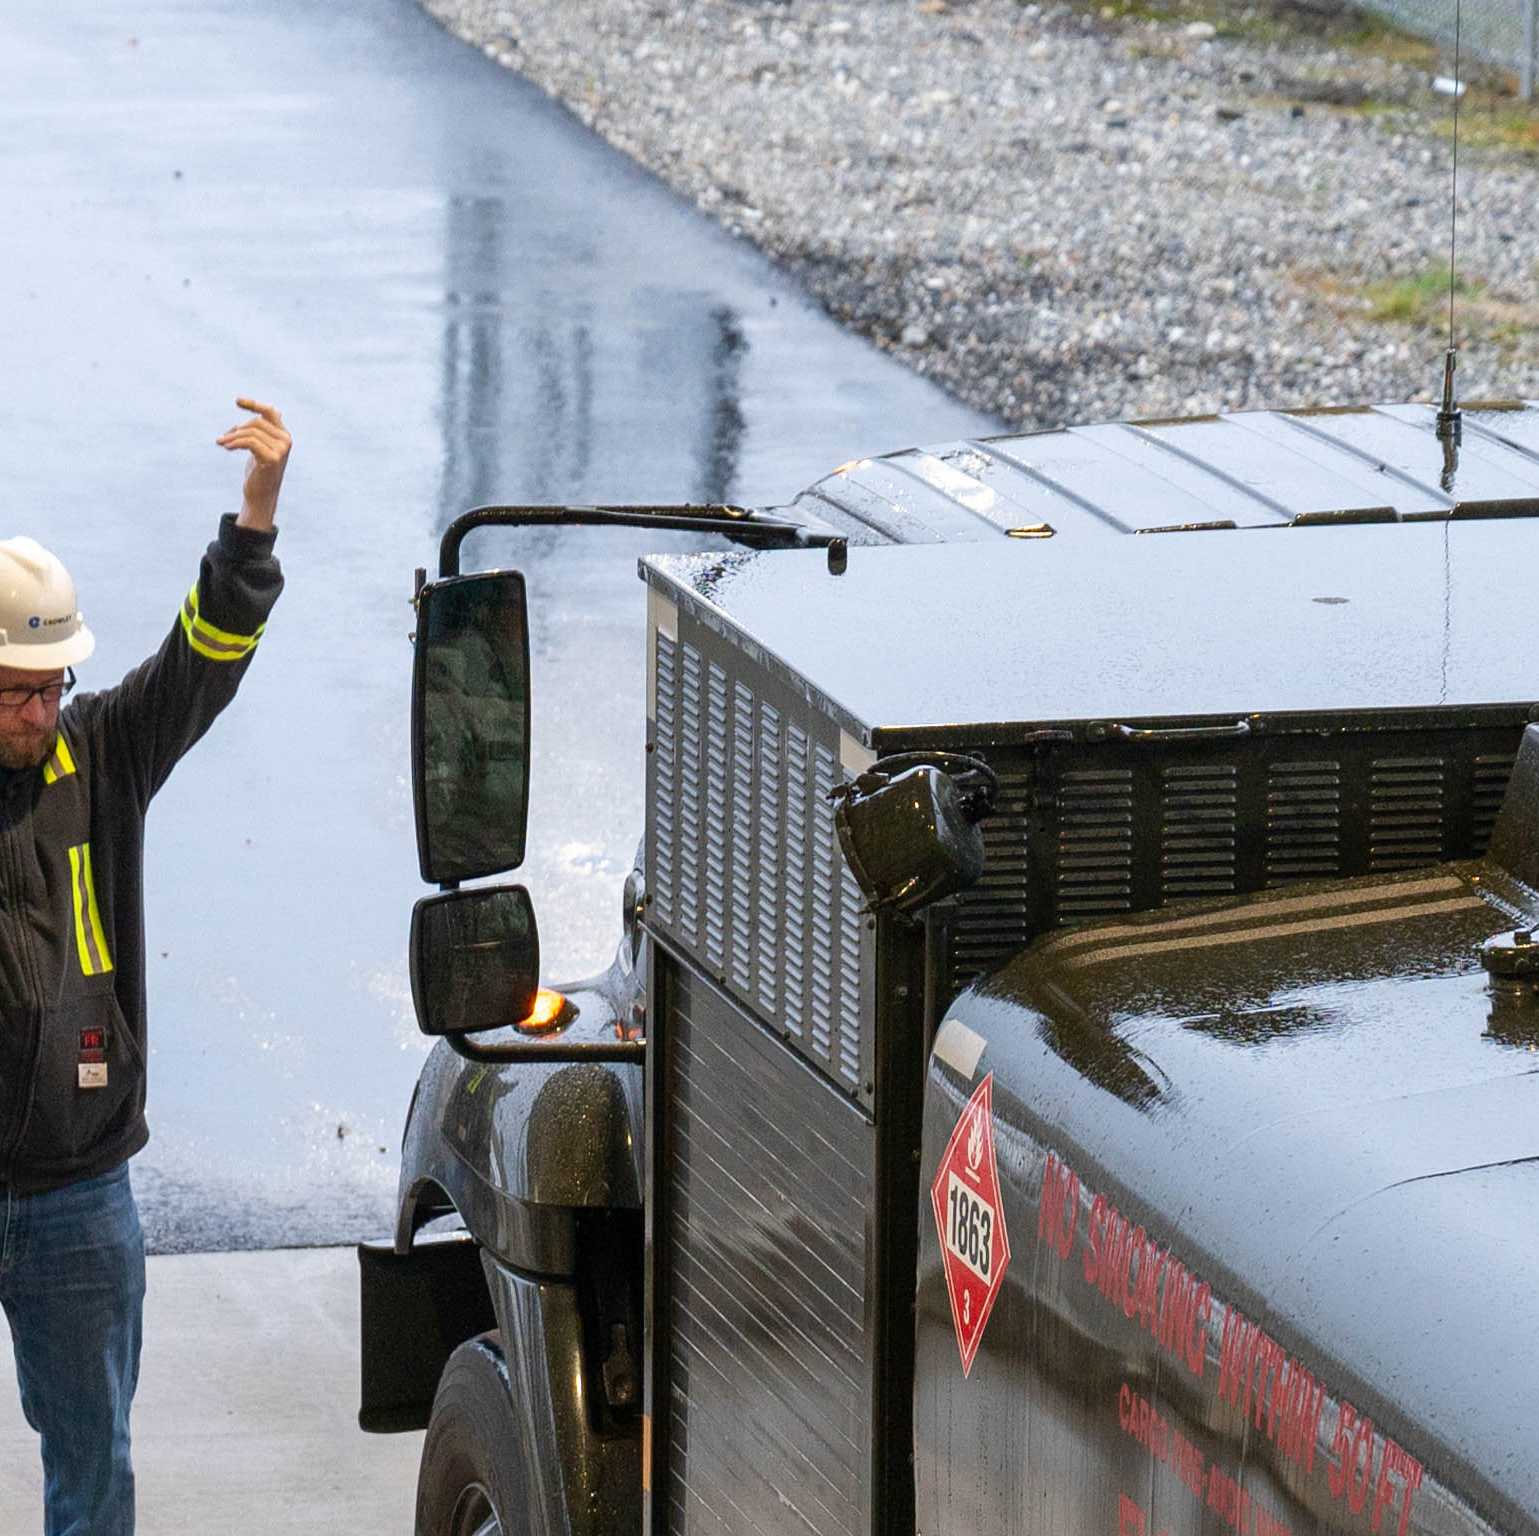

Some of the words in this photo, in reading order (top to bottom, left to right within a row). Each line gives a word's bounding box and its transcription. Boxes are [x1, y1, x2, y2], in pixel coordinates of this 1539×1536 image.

[949, 1185, 992, 1280] 1863
[963, 1288, 971, 1325] 3
[1039, 1153, 1078, 1261] NO
[1084, 1194, 1211, 1378] SMOKING
[1218, 1304, 1326, 1475] WITHIN
[1328, 1401, 1374, 1515] 50
[1119, 1383, 1168, 1465] CARGO
